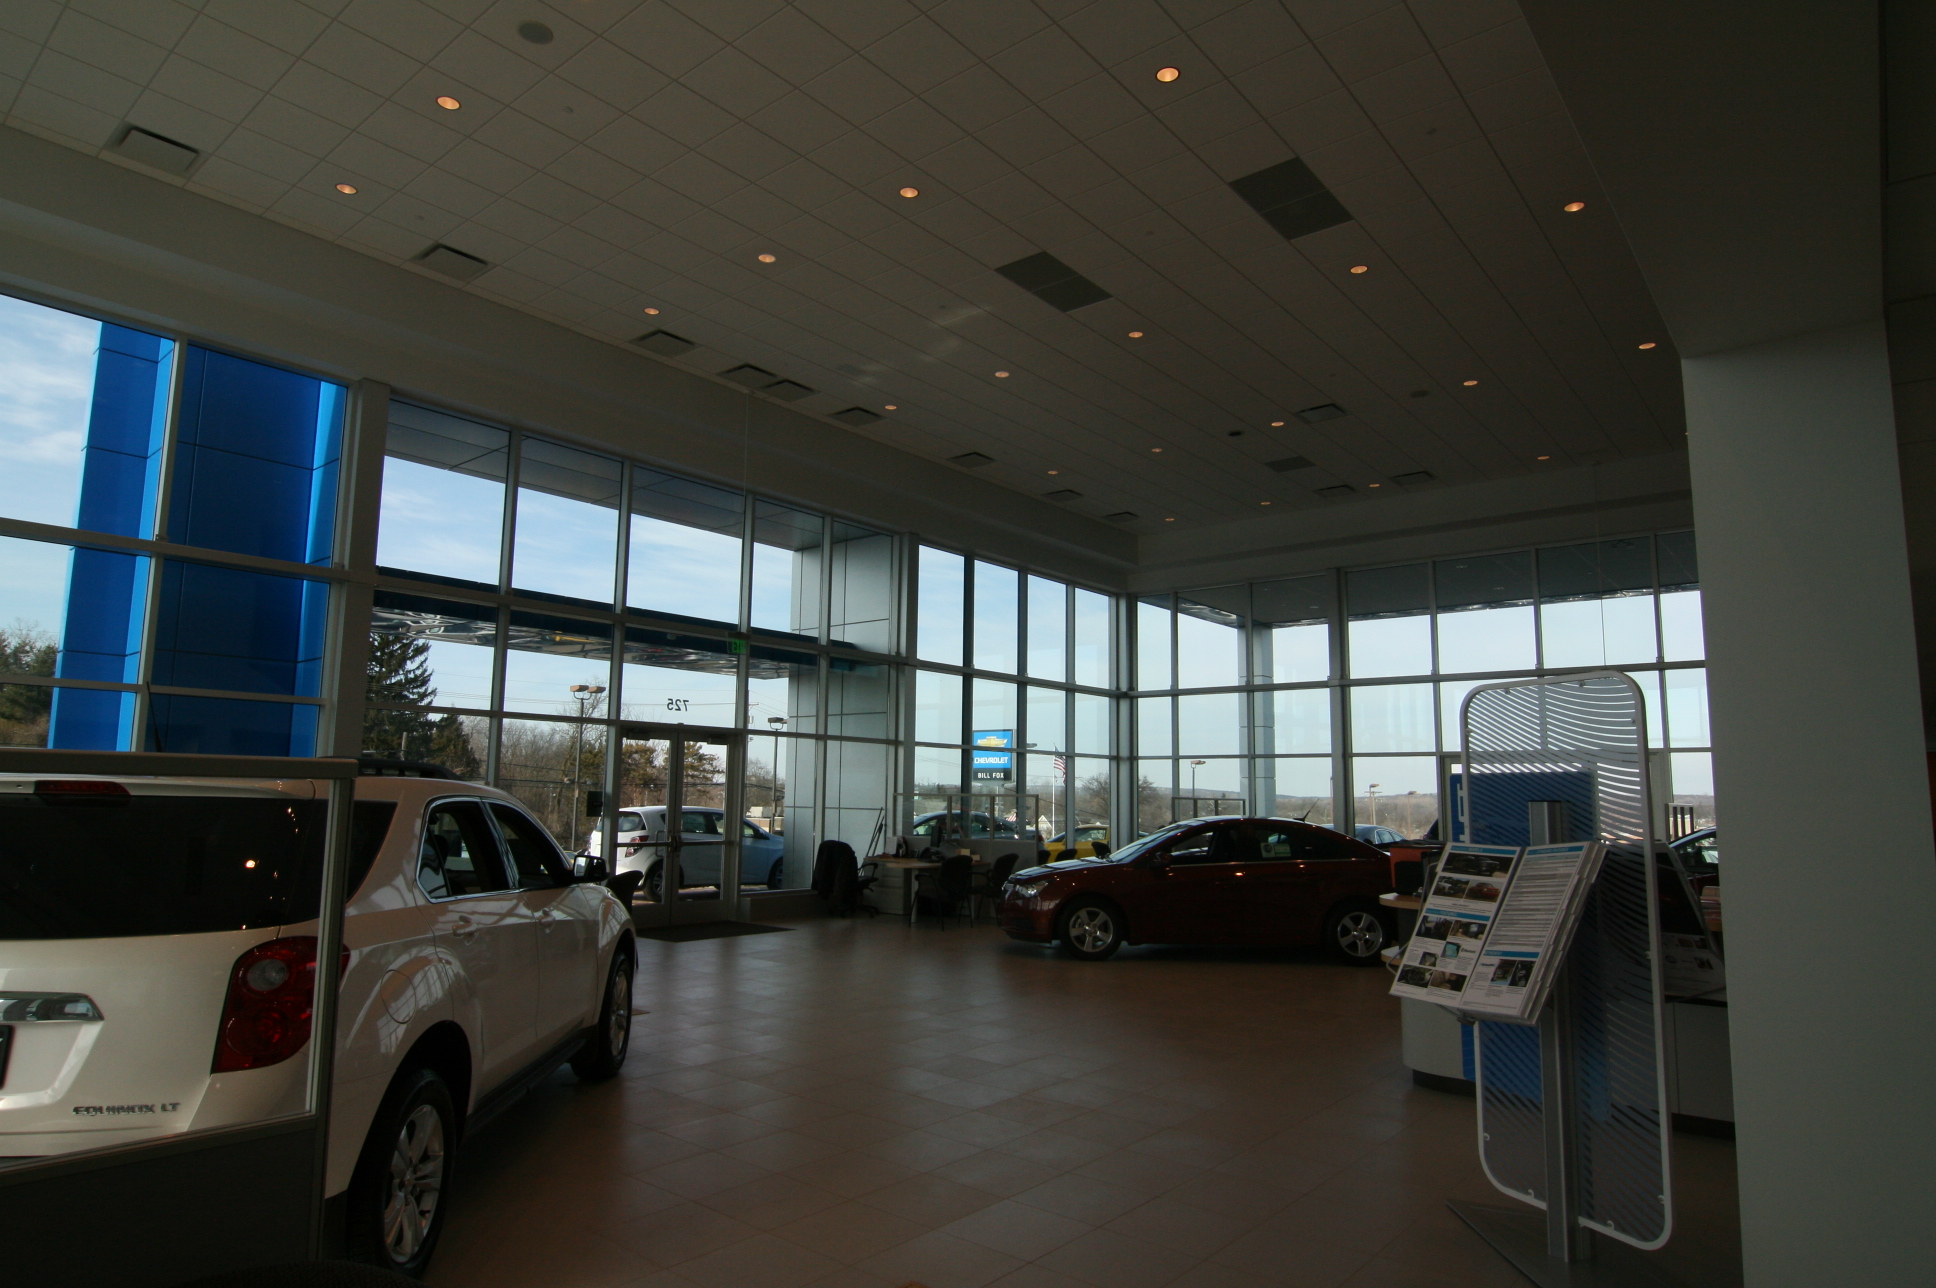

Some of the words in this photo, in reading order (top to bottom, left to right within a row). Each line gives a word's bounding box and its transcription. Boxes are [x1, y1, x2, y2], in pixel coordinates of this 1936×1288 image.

[974, 756, 1009, 764] CHEVROLET
[73, 1104, 155, 1117] EQUINOX
[160, 1102, 180, 1112] LT
